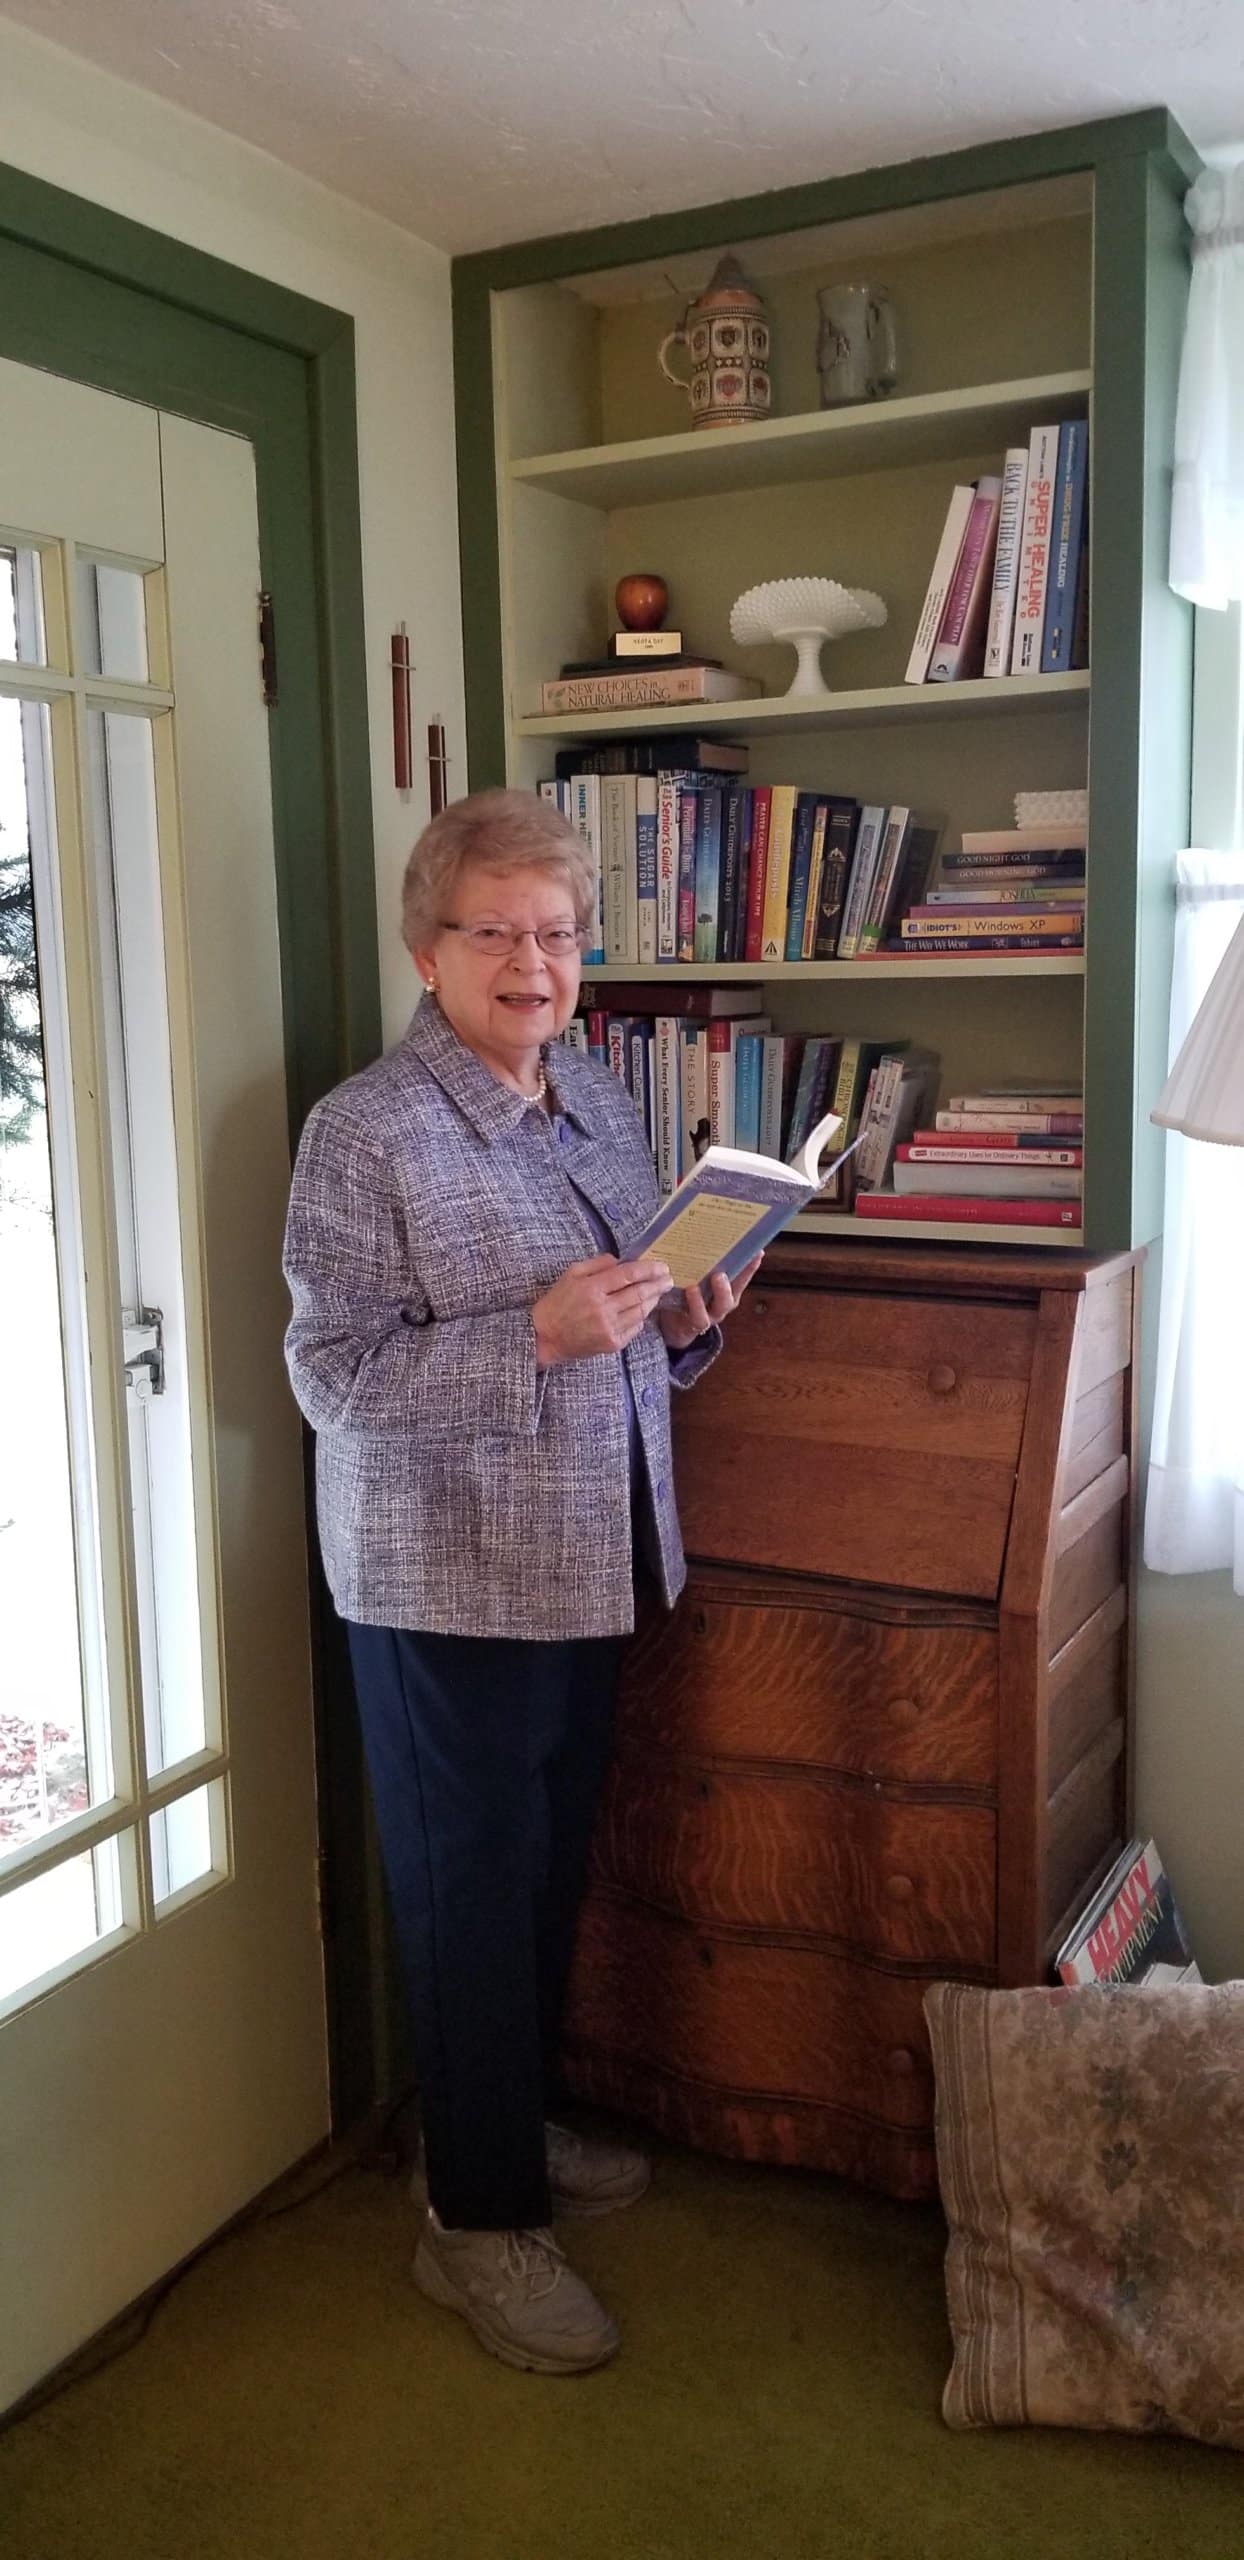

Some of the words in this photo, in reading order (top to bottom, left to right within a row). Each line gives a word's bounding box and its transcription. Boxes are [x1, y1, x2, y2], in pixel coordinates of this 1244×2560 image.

[1003, 463, 1023, 495] BACK
[1002, 500, 1018, 516] TO
[1034, 481, 1051, 537] SUPER
[999, 517, 1017, 545] THE
[994, 548, 1014, 592] FAMILY
[1057, 542, 1069, 588] HEALING
[1027, 543, 1046, 618] HEALING
[567, 683, 595, 695] NEW
[597, 680, 648, 693] CHOICES
[650, 679, 658, 687] in
[568, 694, 620, 708] NATURAL
[621, 688, 671, 705] HEALING
[578, 784, 587, 818] INNER
[728, 798, 737, 824] DAILY
[661, 801, 673, 845] Senior's
[758, 803, 767, 830] PRAYER
[726, 825, 737, 878] GUIDEPOSTS
[757, 831, 765, 848] CAN
[638, 826, 647, 888] SOLUTION
[647, 848, 655, 887] SUGAR
[661, 846, 673, 880] Guide
[756, 848, 765, 879] CHANGE
[957, 855, 979, 864] GOOD
[980, 854, 1008, 864] NIGHT
[1010, 853, 1031, 862] GOD
[959, 869, 981, 878] GOOD
[1026, 865, 1046, 874] GOD
[755, 880, 763, 901] YOUR
[793, 876, 804, 905] Mitch
[790, 908, 802, 940] Albom
[926, 923, 957, 932] IDIOT'S
[974, 920, 1024, 931] Windows
[1030, 919, 1046, 930] XP
[904, 940, 918, 950] THE
[918, 940, 933, 950] WAY
[935, 940, 948, 950] WE
[948, 940, 968, 949] WORK
[611, 1035, 624, 1077] Kitche
[632, 1043, 642, 1075] Kitchen
[661, 1038, 669, 1060] What
[687, 1048, 695, 1070] THE
[767, 1048, 777, 1071] DAILY
[660, 1062, 669, 1085] Every
[711, 1060, 721, 1097] Super
[633, 1076, 642, 1102] Cures
[661, 1087, 669, 1115] Senior
[687, 1075, 696, 1114] STORY
[662, 1116, 671, 1145] Should
[711, 1100, 721, 1145] Smooth
[662, 1146, 670, 1171] Know
[929, 1150, 967, 1160] Extraordinary
[968, 1150, 983, 1159] Uses
[992, 1151, 1019, 1161] Ordinary
[1020, 1151, 1041, 1161] Things
[1087, 1856, 1154, 1981] HEAVY
